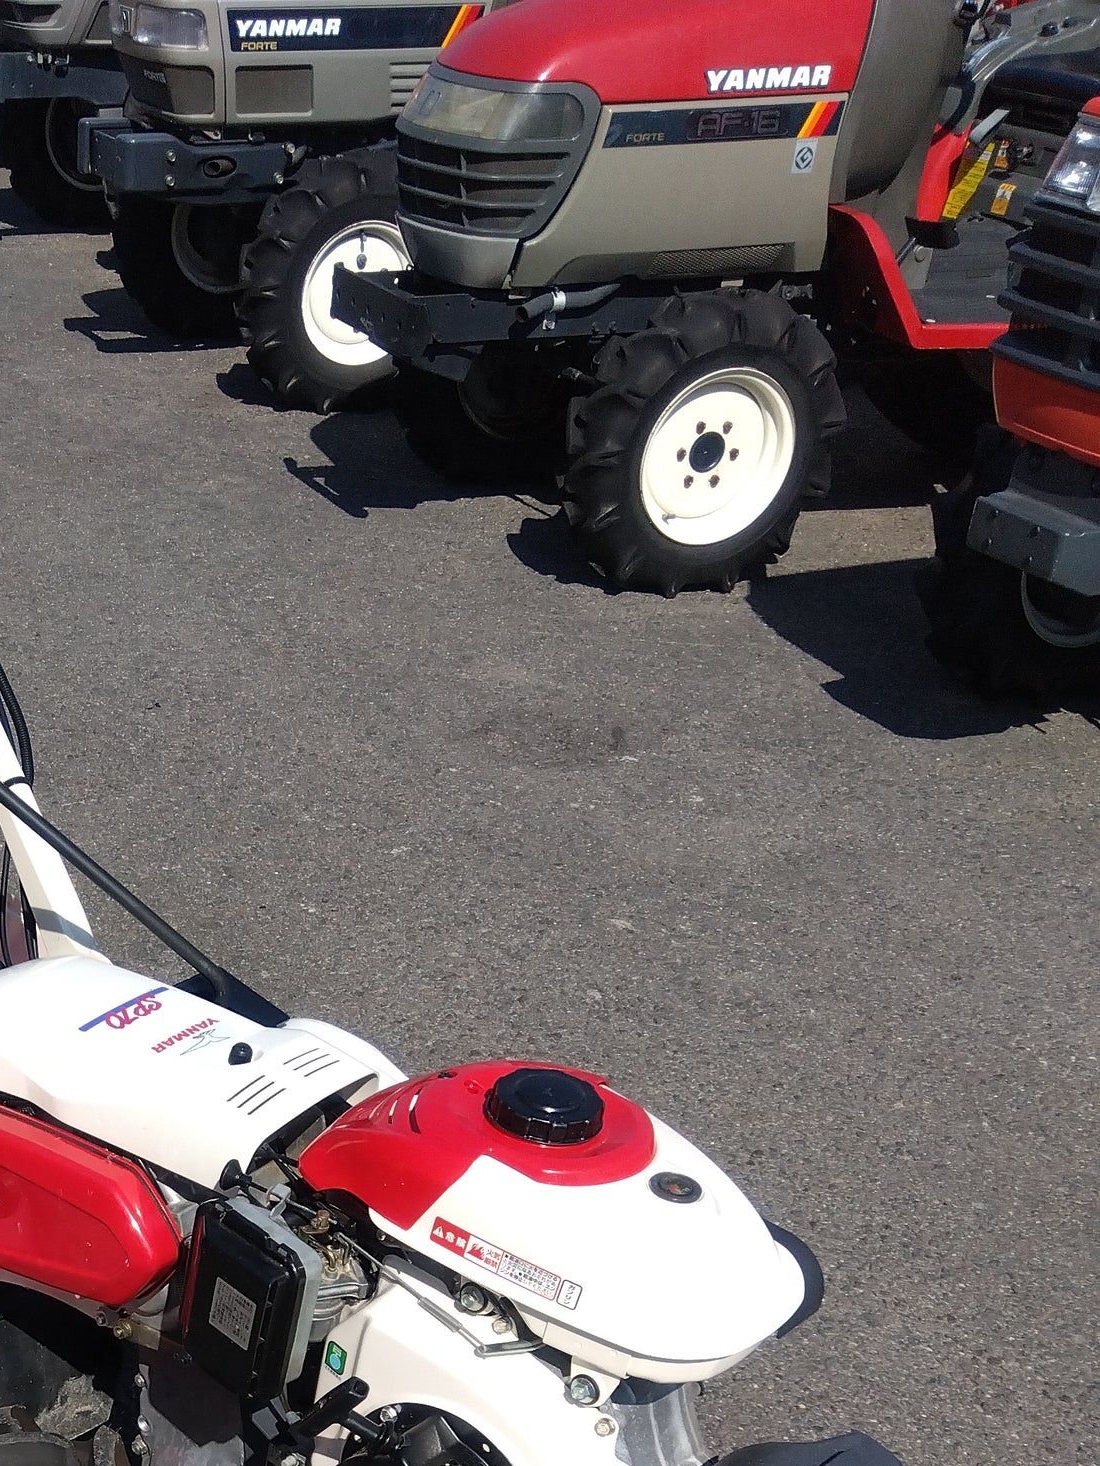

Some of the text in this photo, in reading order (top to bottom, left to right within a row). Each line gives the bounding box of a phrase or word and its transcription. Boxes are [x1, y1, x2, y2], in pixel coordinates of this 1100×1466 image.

[236, 18, 342, 38] YANMAR
[240, 41, 278, 51] FORTE
[706, 64, 832, 93] YANMAR
[625, 132, 666, 143] FORTE
[151, 1018, 220, 1053] YANMAR
